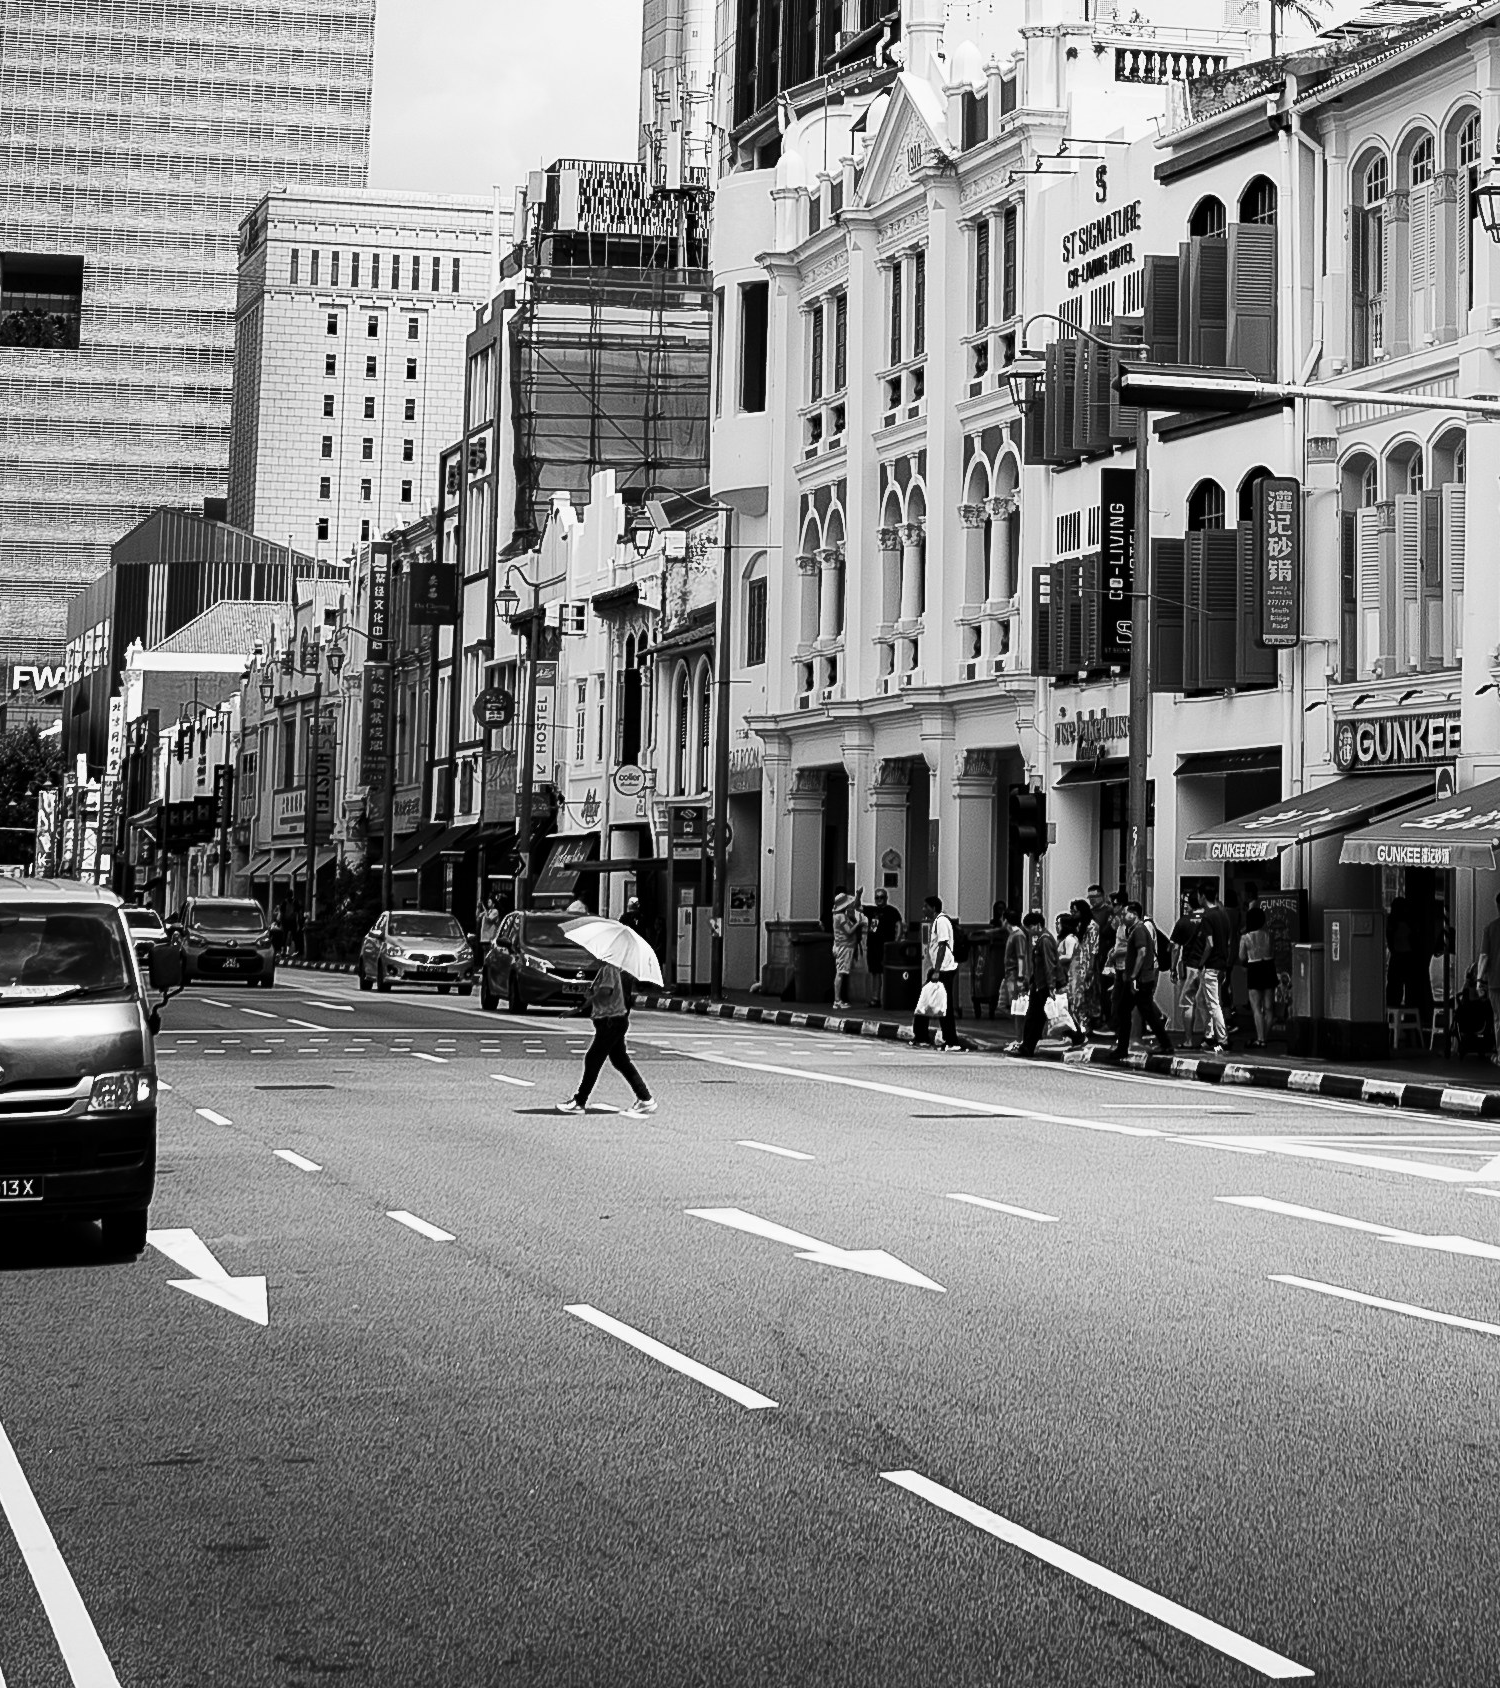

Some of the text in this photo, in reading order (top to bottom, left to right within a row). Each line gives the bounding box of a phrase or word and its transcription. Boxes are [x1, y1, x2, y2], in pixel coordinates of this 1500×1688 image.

[1062, 200, 1141, 263] ST SIGNATURE
[1109, 502, 1126, 601] CO-LIVING
[536, 696, 547, 754] HOSTEL
[1356, 716, 1461, 764] GUNKEE
[1377, 846, 1420, 863] GUNKEE
[1260, 899, 1297, 912] GUNKEE
